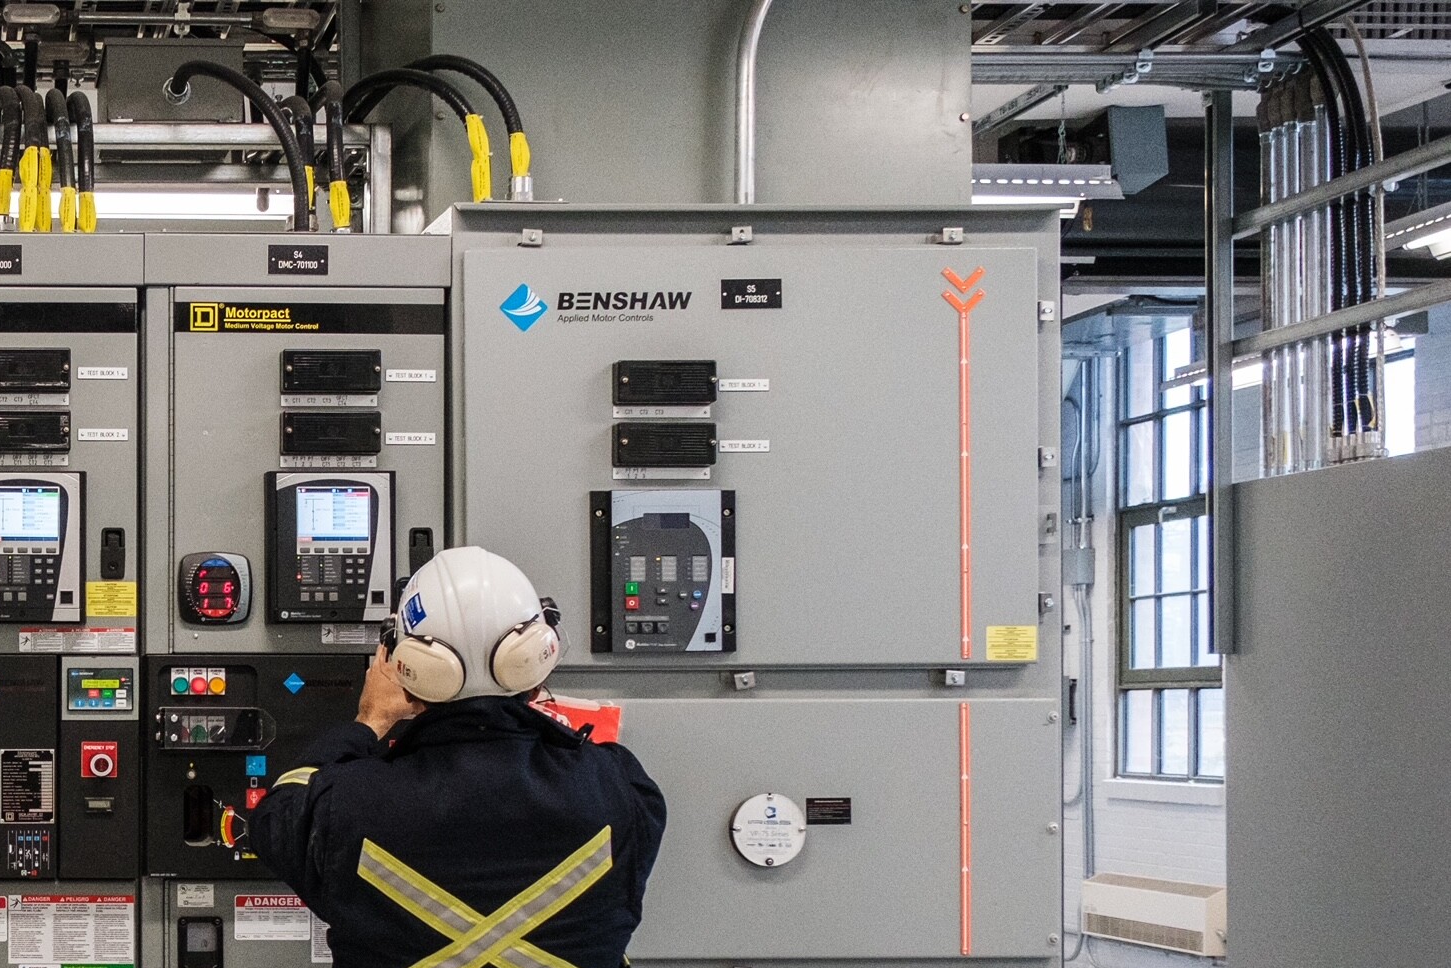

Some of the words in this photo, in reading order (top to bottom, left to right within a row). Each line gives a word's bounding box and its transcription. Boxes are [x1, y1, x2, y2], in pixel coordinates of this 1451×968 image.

[293, 250, 303, 259] S4
[278, 260, 318, 269] DMC-701100
[746, 284, 756, 293] S5
[556, 291, 693, 311] BENSHAW
[225, 306, 290, 320] Motorpact
[557, 314, 589, 323] Applied
[592, 314, 615, 322] Motor
[618, 314, 654, 322] Controls
[225, 322, 250, 330] Medium
[250, 322, 275, 330] Voltage
[253, 896, 301, 906] DANGER
